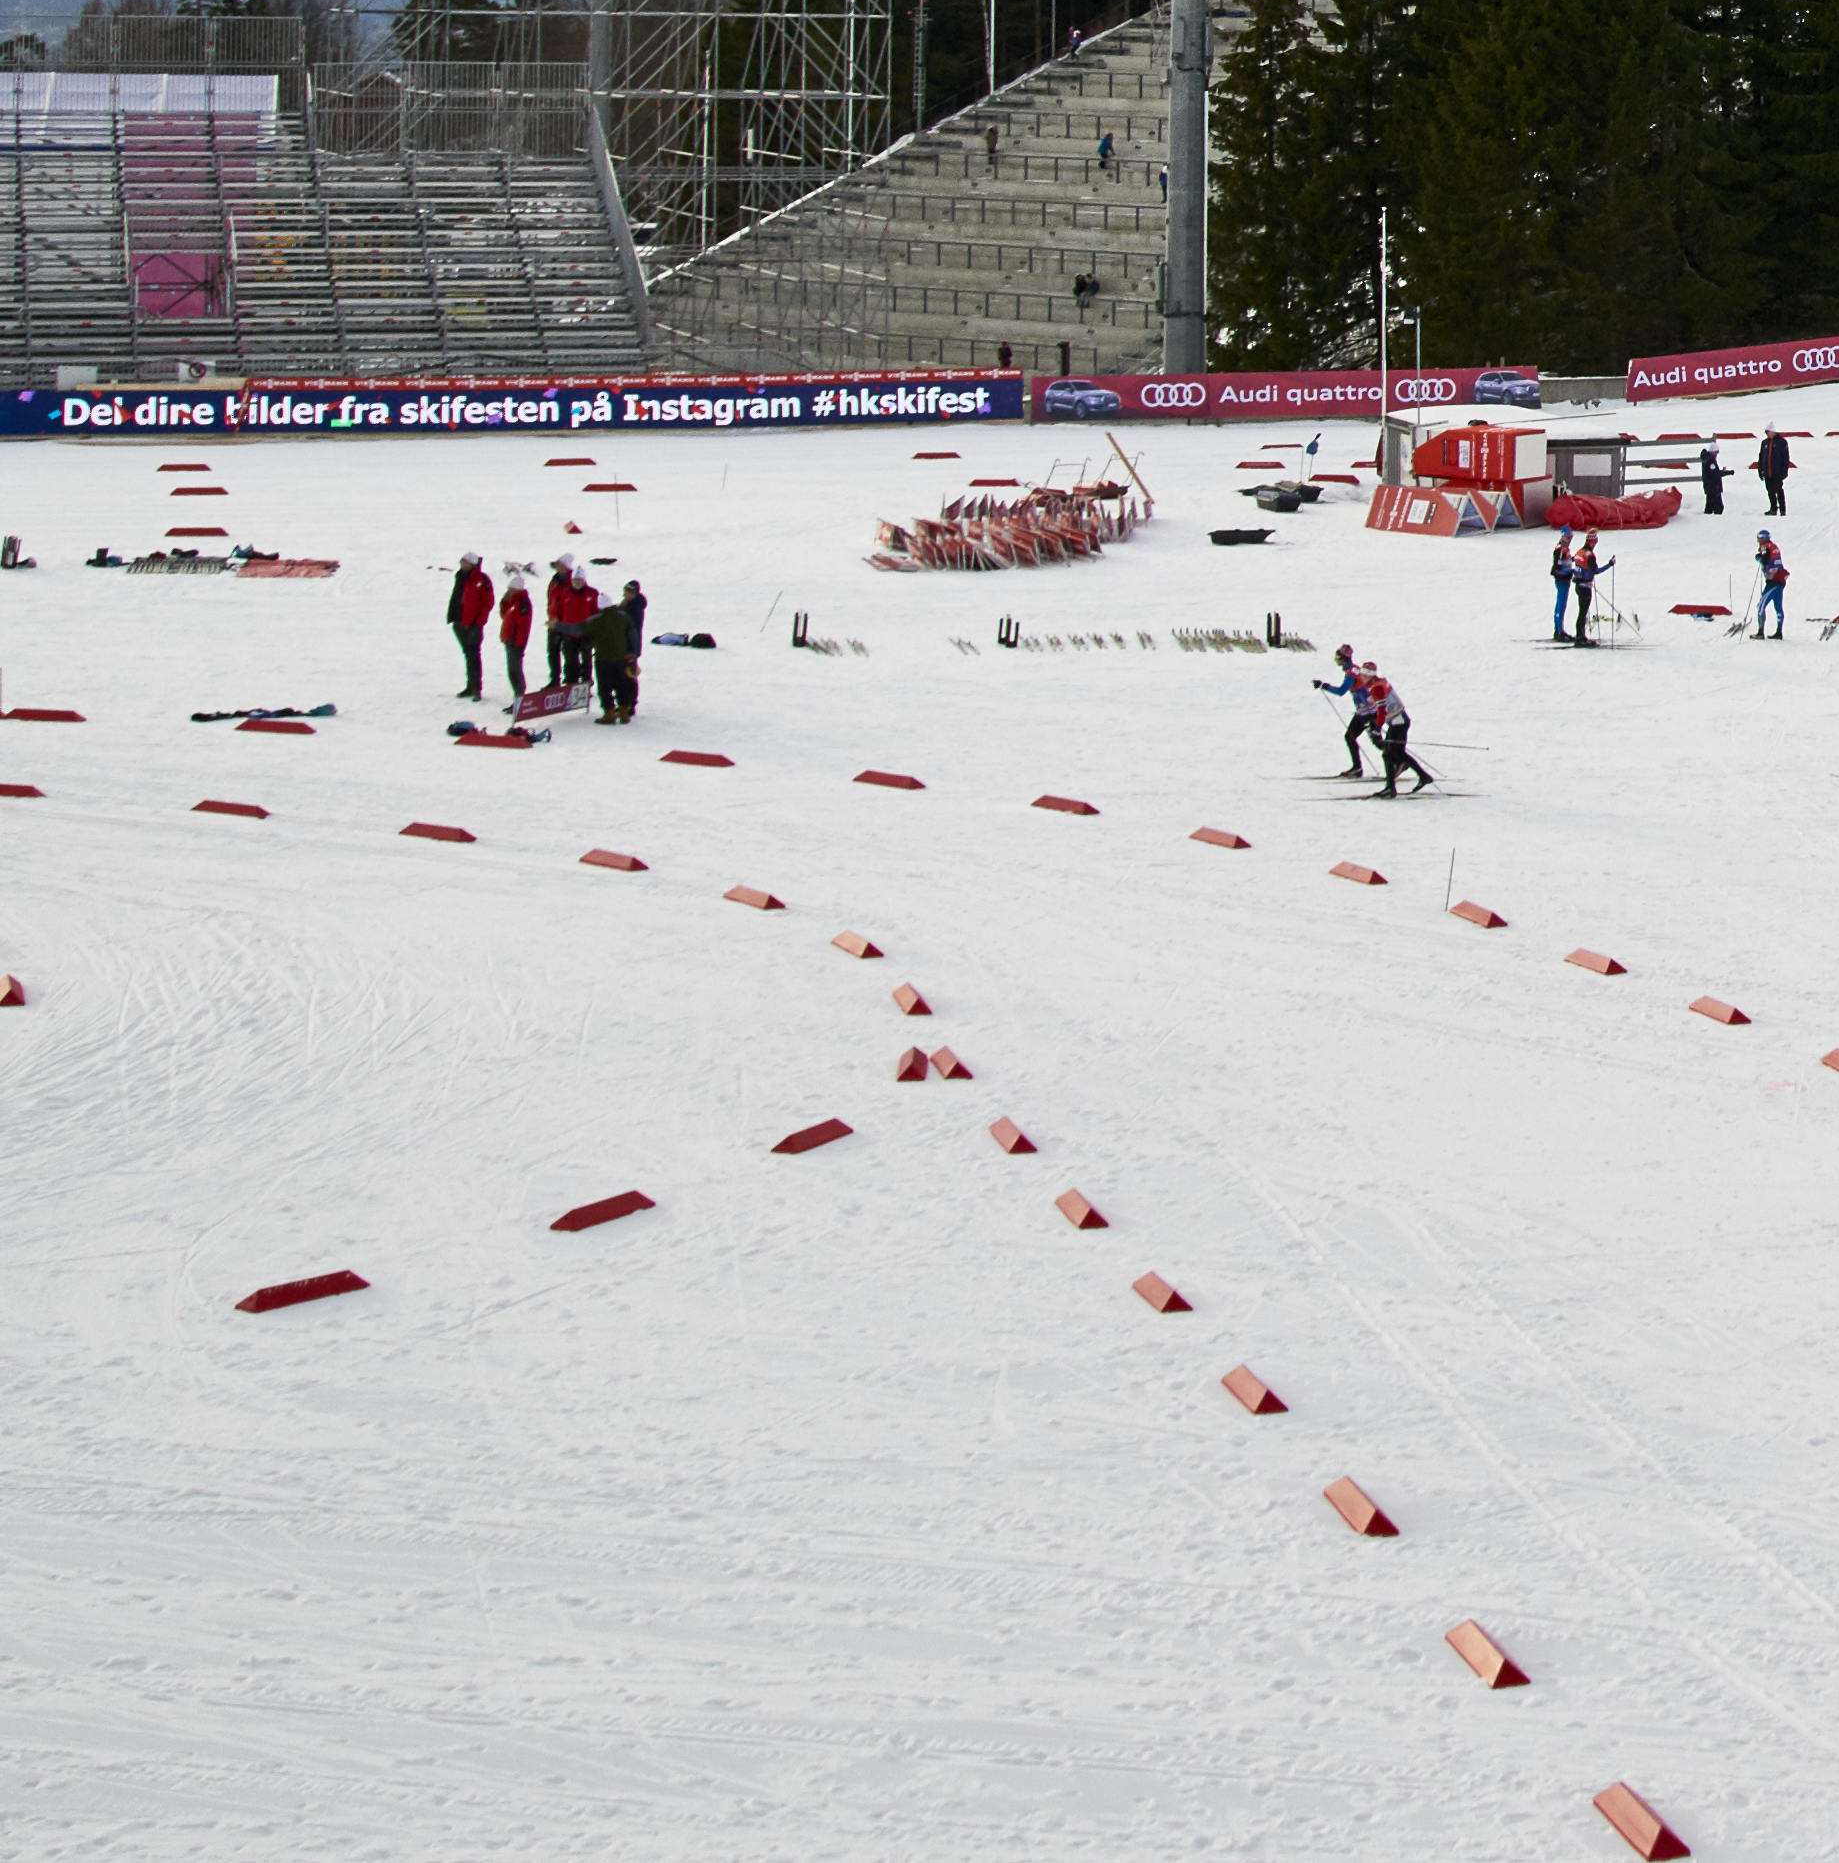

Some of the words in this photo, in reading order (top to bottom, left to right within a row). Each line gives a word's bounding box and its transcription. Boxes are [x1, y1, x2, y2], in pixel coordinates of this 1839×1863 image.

[1633, 366, 1687, 388] Audi
[1694, 359, 1782, 384] quattro
[62, 396, 124, 426] Del
[134, 395, 215, 426] dine
[224, 395, 328, 426] bilder
[338, 395, 390, 425] fra
[400, 394, 560, 425] skifesten
[570, 391, 612, 428] på
[623, 393, 801, 427] Instagram
[812, 386, 991, 417] #hkskifest
[1219, 385, 1278, 403] Audi
[1286, 385, 1382, 406] quattro
